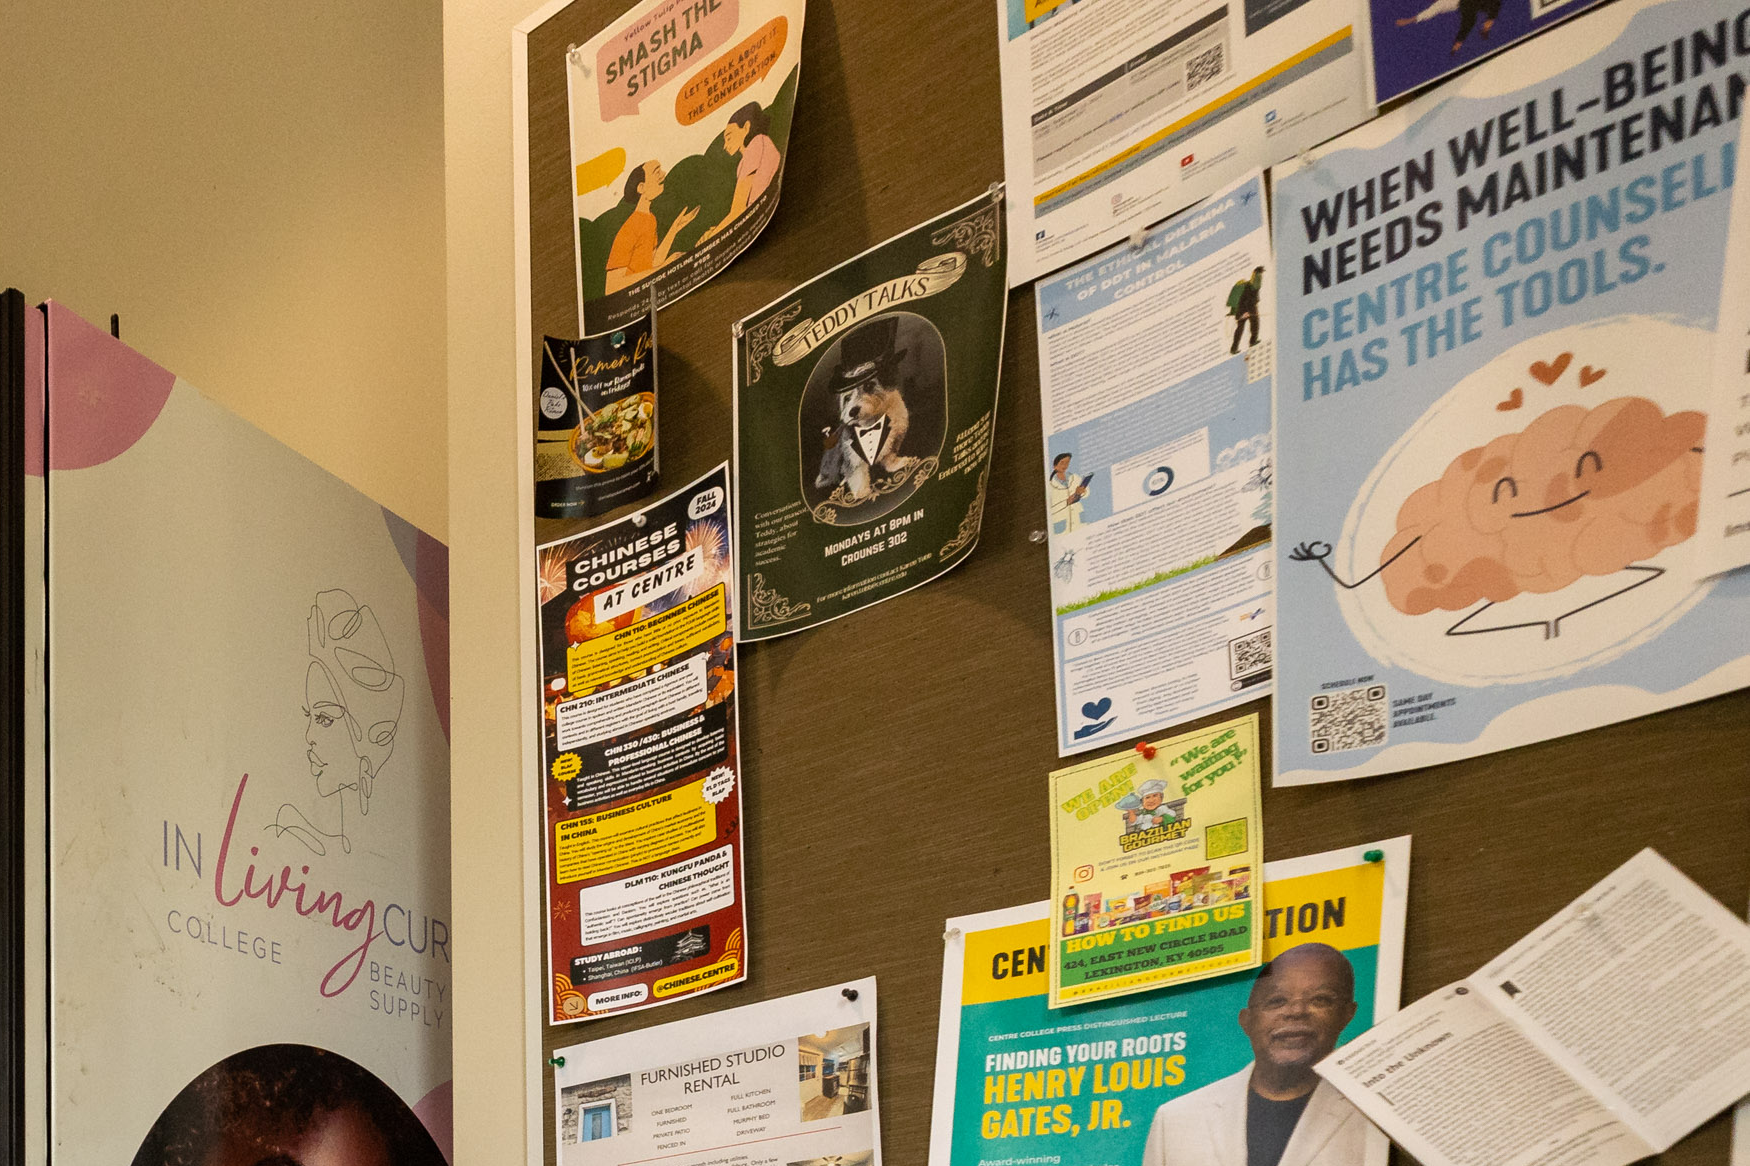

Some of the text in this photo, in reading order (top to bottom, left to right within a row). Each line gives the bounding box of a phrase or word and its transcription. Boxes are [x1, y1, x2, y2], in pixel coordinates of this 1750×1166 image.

[606, 0, 722, 85] SMASH THE
[627, 31, 703, 97] STIGMA
[684, 27, 778, 99] LET'S TALK ABOUT IT
[687, 52, 776, 120] THE CONVERSATION
[707, 54, 759, 96] BE PART OF
[1301, 148, 1436, 244] WHEN
[1303, 201, 1445, 296] NEEDS
[800, 276, 931, 351] TEDDY TALKS
[1302, 247, 1468, 350] CENTRE
[1303, 336, 1390, 402] HAS
[1400, 295, 1484, 367] THE
[1495, 234, 1666, 328] TOOLS.
[695, 501, 716, 514] 2024
[696, 492, 716, 505] FALL
[574, 522, 678, 574] CHINESE
[825, 508, 924, 557] MONDAYS AT 8PM IN
[841, 532, 907, 567] CROUNSE 302
[573, 539, 680, 591] COURSES
[603, 554, 695, 611] AT CENTRE
[614, 590, 719, 641] CHN 110: BEGINNER CHINESE
[1120, 818, 1191, 846] BRAZILIAN
[1123, 829, 1187, 852] GOURMET
[163, 820, 202, 880] IN
[214, 773, 385, 998] living
[624, 850, 727, 889] DLM 110: KUNGFU PANDA &
[658, 861, 730, 891] CHINESE THOUGHT
[167, 910, 282, 965] COLLEGE
[992, 943, 1050, 980] CEN
[1263, 897, 1346, 940] TION
[1064, 925, 1248, 971] 424, EAST NEW CIRCLE ROAD
[1066, 904, 1245, 954] HOW TO FIND US
[575, 946, 642, 967] STUDY ABROAD:
[1084, 944, 1225, 981] LEXINGTON, KY 40505
[370, 961, 446, 1000] BEAUTY
[595, 990, 642, 1005] MORE INFO:
[370, 990, 444, 1029] SUPPLY
[640, 1045, 785, 1086] FURNISHED STUDIO
[985, 1031, 1187, 1073] FINDING YOUR ROOTS
[1363, 1032, 1452, 1089] Into the Unknown
[684, 1072, 740, 1095] RENTAL
[745, 1088, 771, 1098] KITCHEN
[984, 1054, 1186, 1105] HENRY LOUIS
[665, 1104, 693, 1114] BEDROOM
[742, 1100, 776, 1111] BATHROOM
[981, 1099, 1131, 1140] GATES, JR.
[736, 1126, 766, 1136] DRIVEWAY
